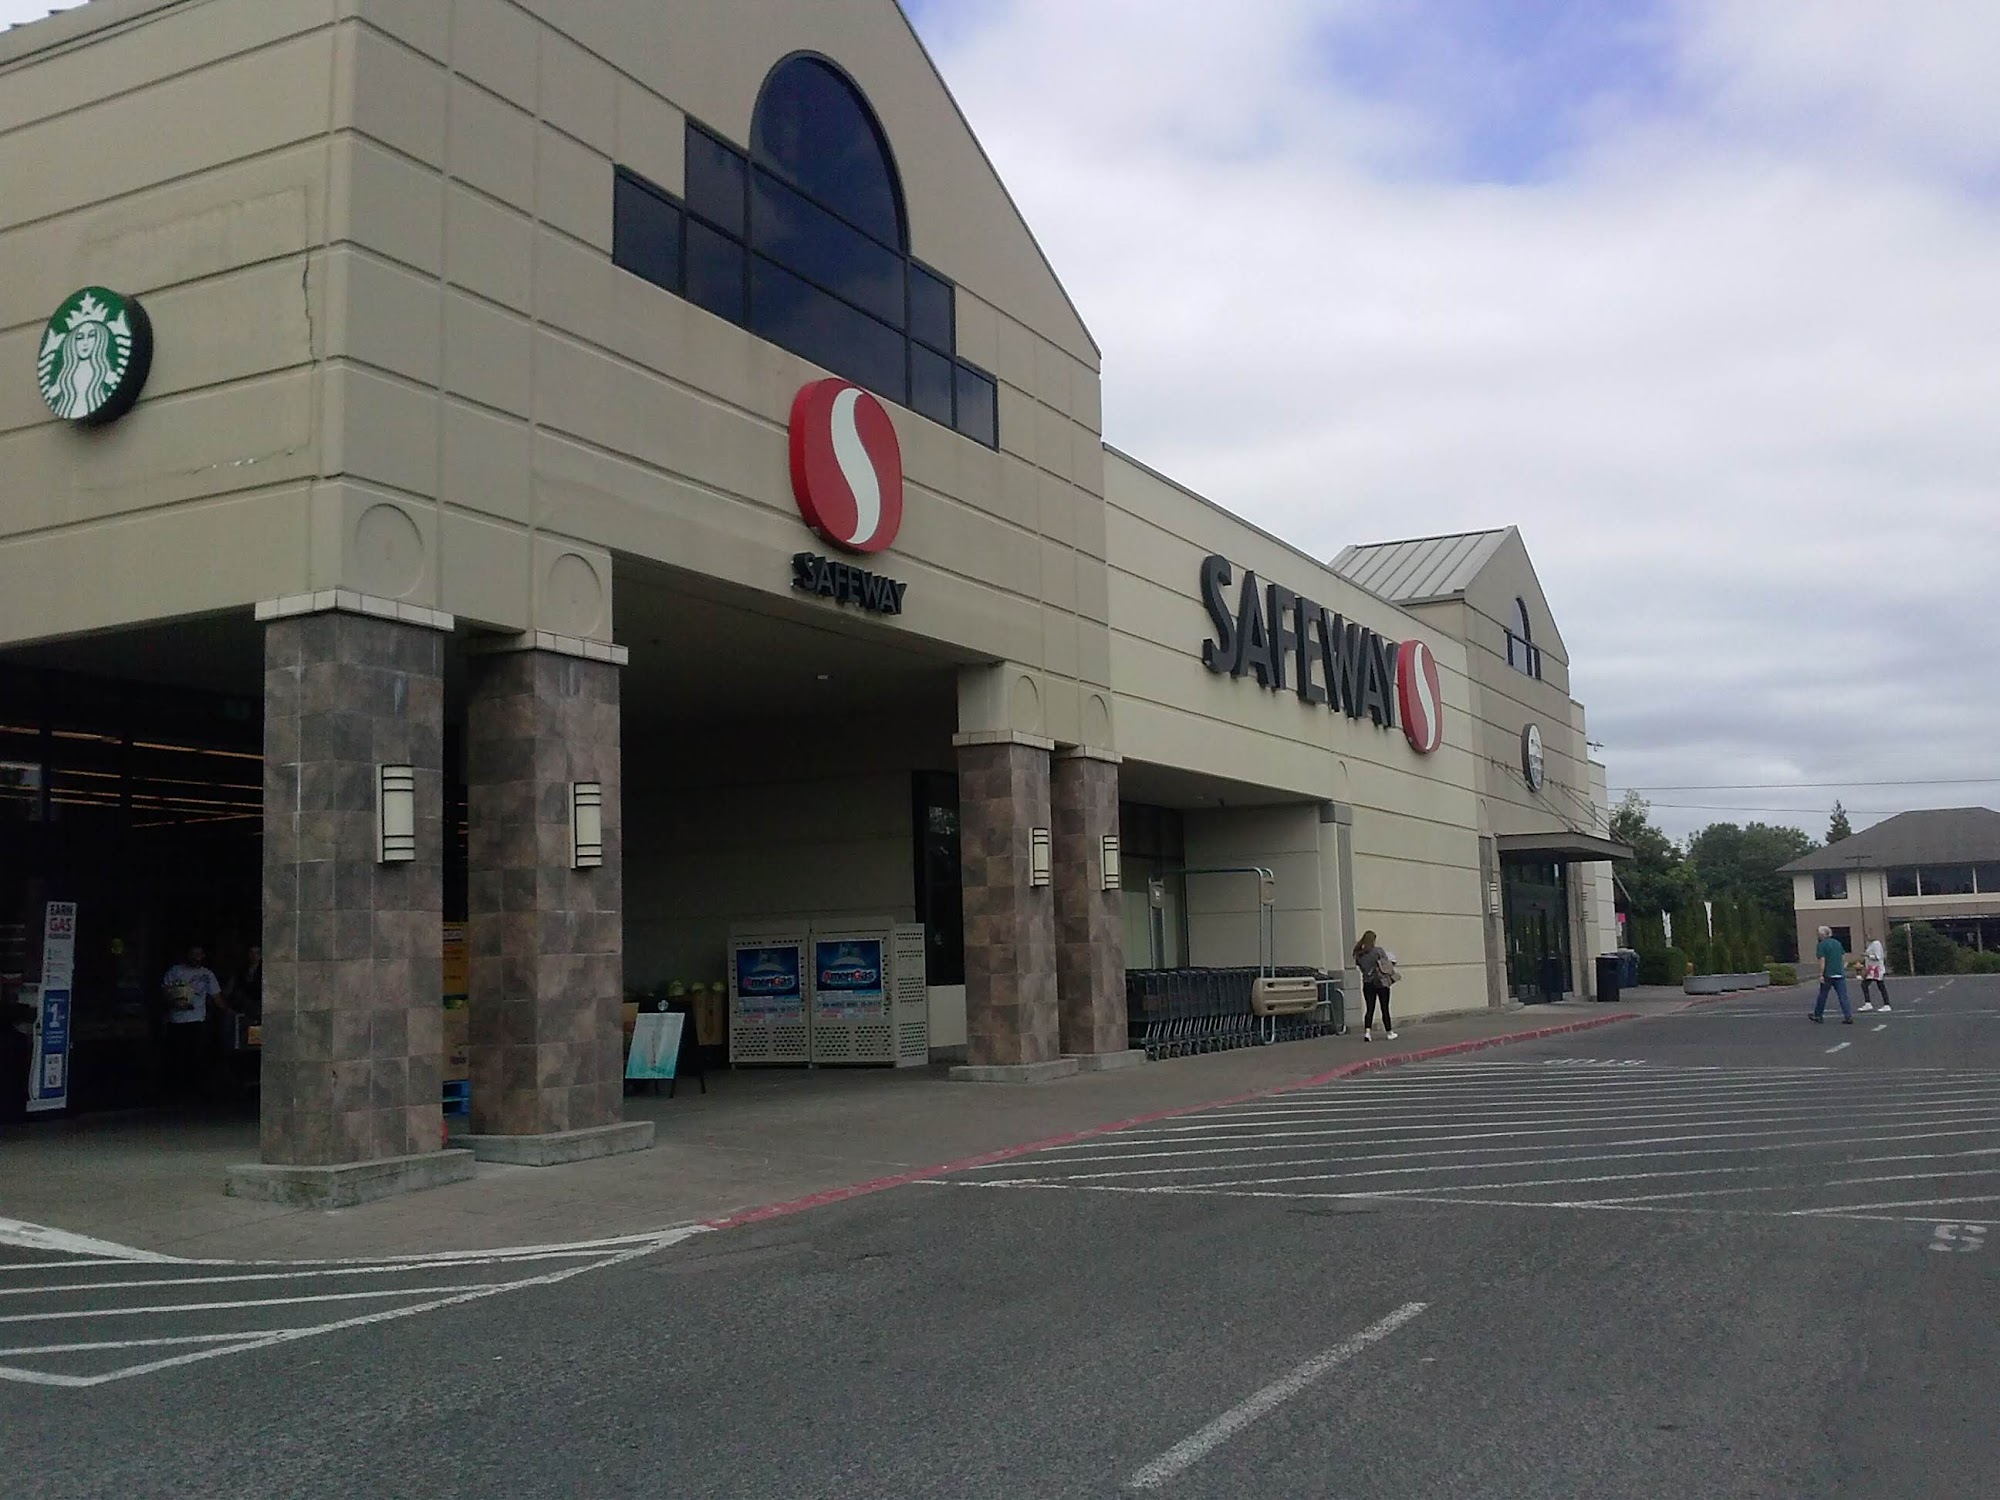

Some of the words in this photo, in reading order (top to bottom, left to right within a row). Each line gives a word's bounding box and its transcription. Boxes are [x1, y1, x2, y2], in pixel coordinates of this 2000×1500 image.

[791, 552, 907, 615] SAFEWAY
[1201, 554, 1399, 729] SAFEWAY
[50, 917, 72, 931] GAS
[823, 969, 875, 981] AmeriGas
